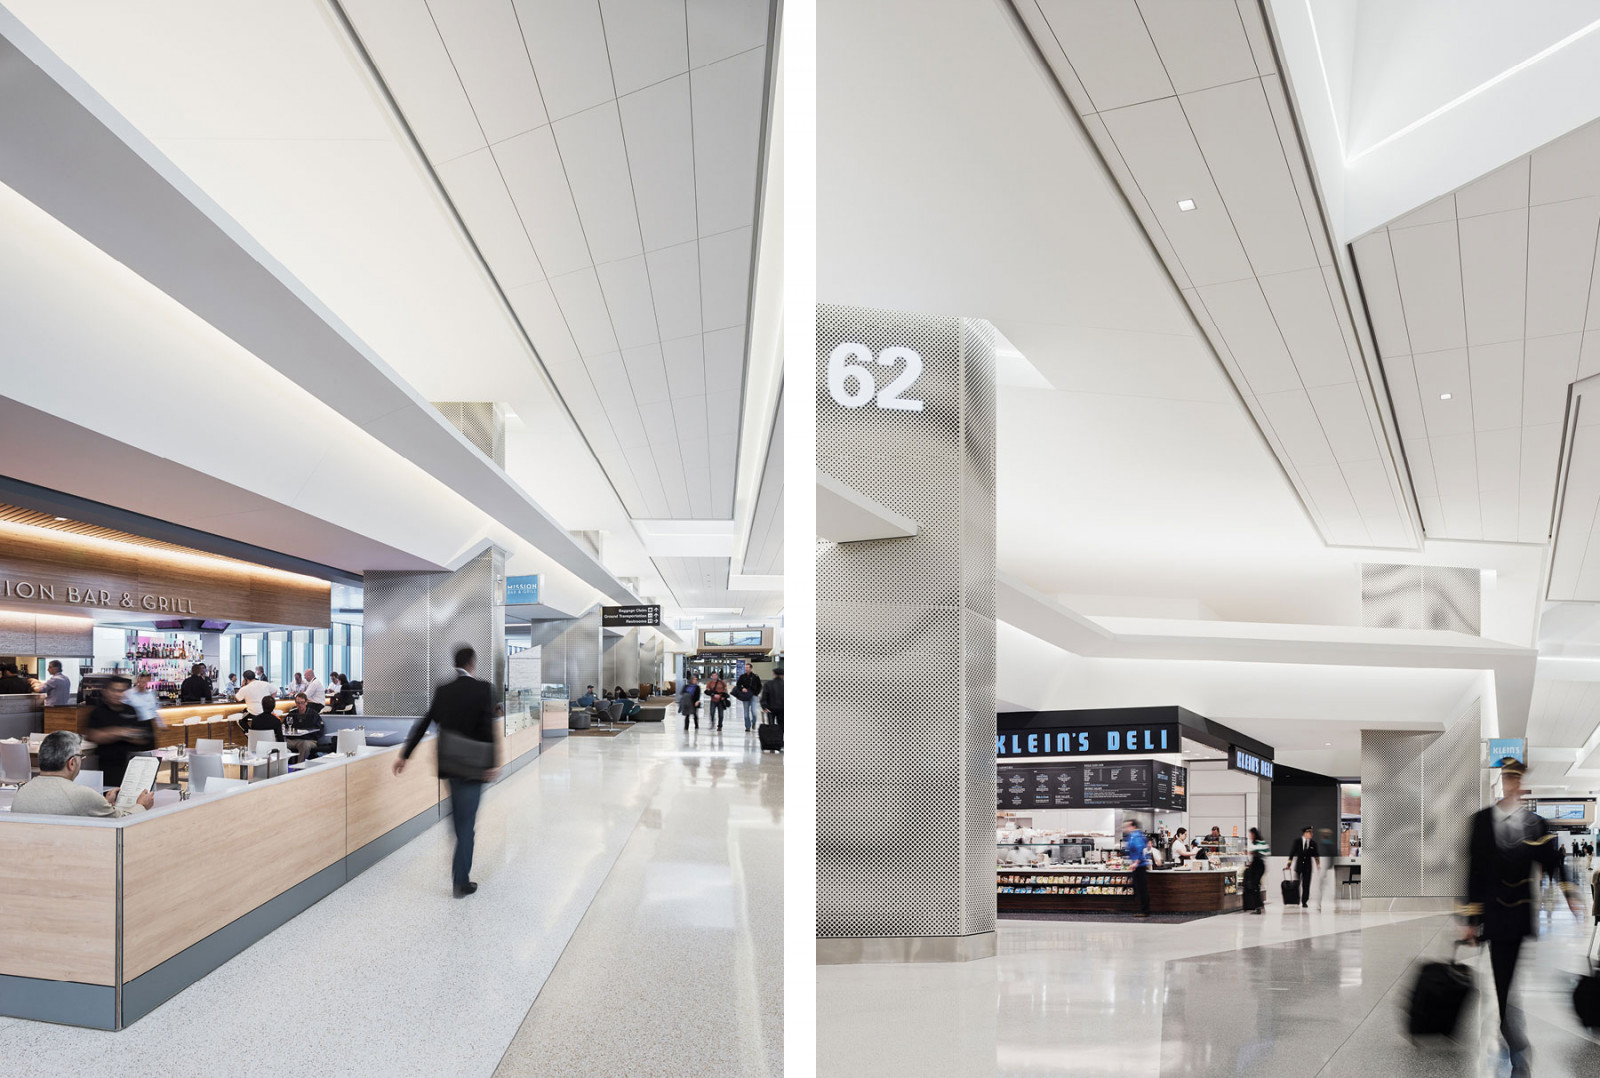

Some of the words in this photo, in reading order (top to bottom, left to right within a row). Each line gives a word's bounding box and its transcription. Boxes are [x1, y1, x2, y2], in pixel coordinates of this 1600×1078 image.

[828, 342, 924, 411] 62
[0, 580, 55, 600] ION
[67, 587, 112, 606] BAR
[120, 592, 135, 608] &
[142, 594, 197, 614] GRILL
[997, 732, 1089, 755] KLEIN'S
[1107, 729, 1168, 751] DELI
[1493, 746, 1520, 754] KLEIN'S
[1236, 751, 1260, 774] KLEIN'S
[1260, 759, 1273, 778] DELI
